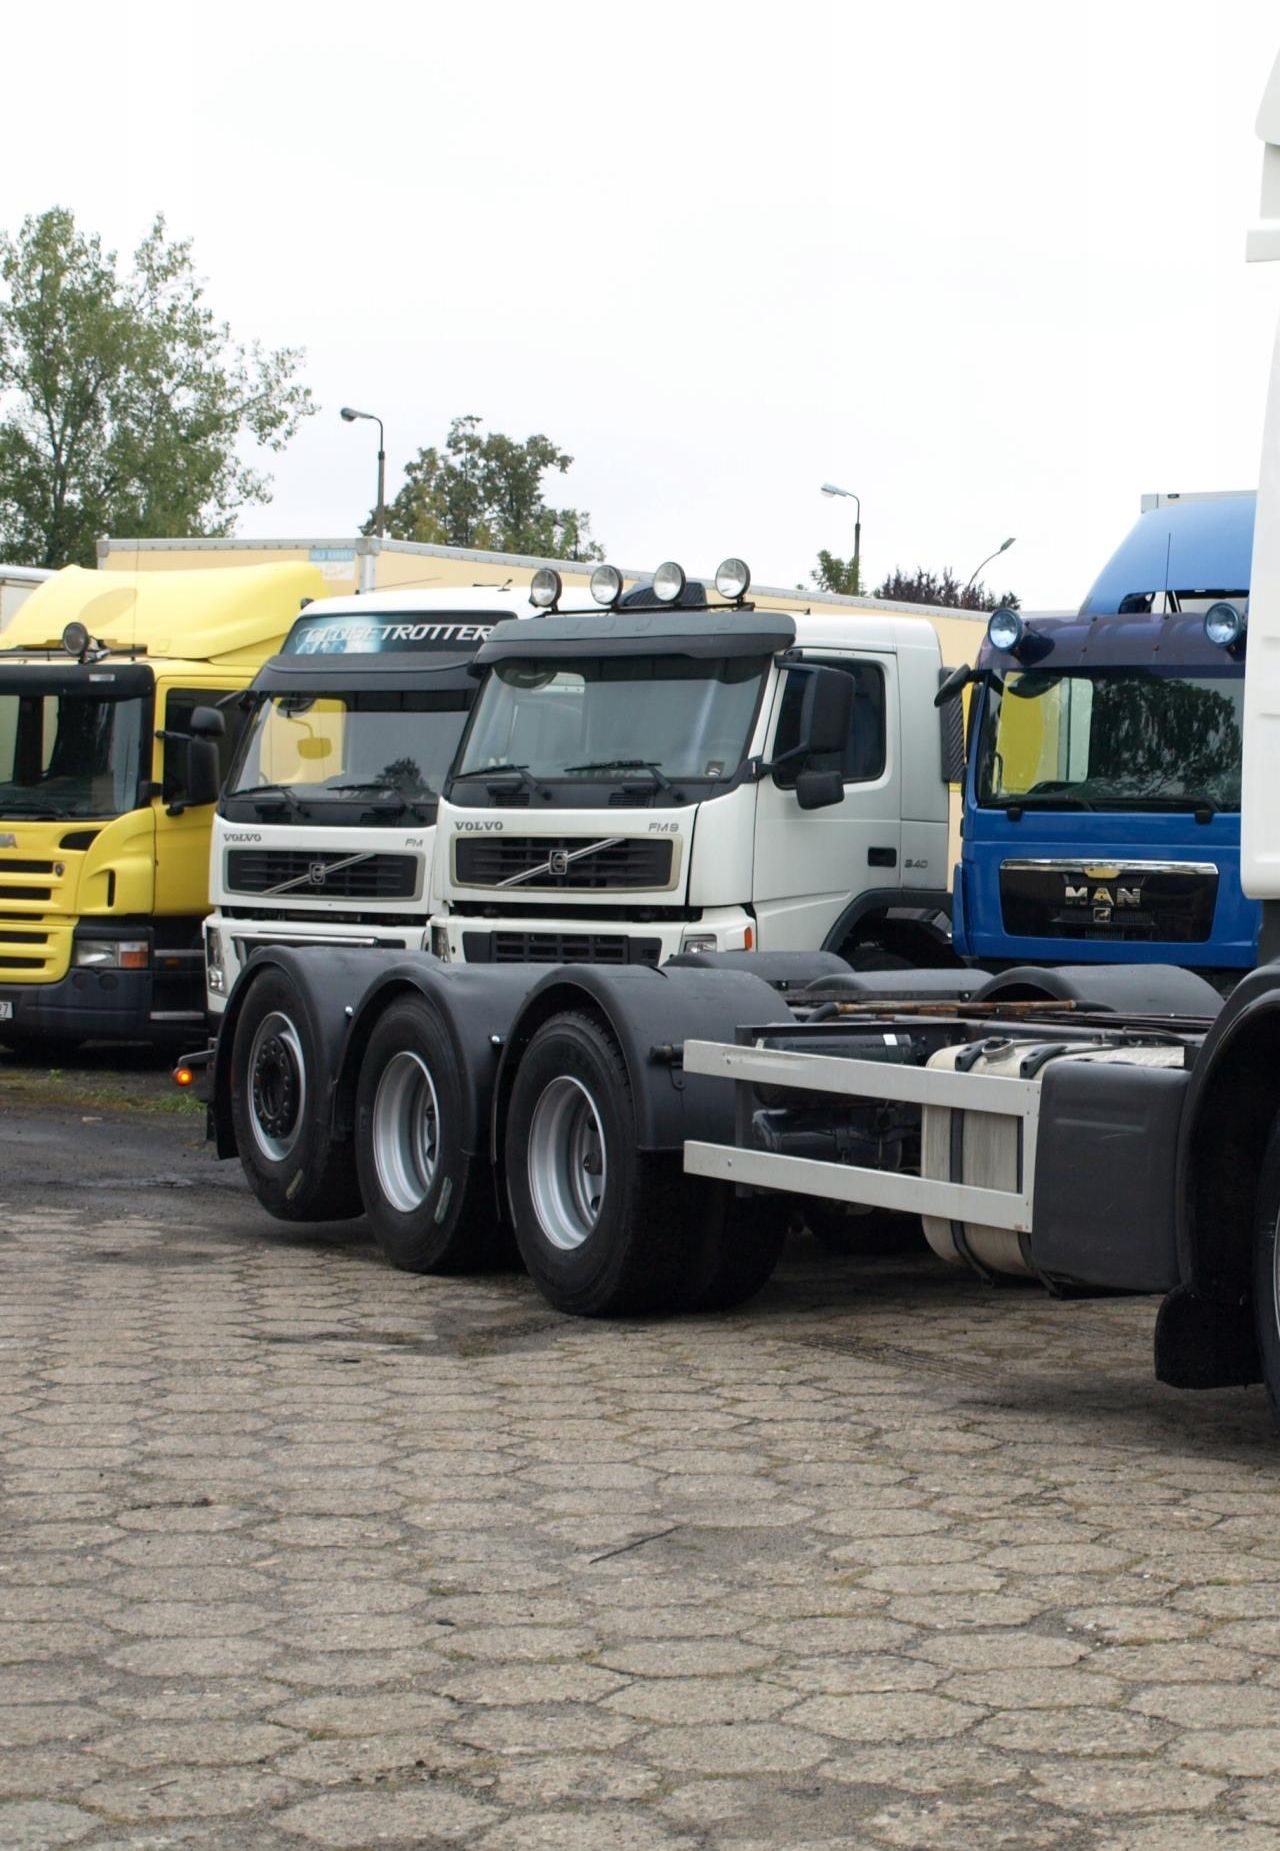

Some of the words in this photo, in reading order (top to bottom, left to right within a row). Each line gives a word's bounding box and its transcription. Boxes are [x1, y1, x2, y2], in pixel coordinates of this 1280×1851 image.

[454, 820, 504, 831] VOLVO
[648, 822, 679, 833] FM9
[223, 833, 262, 843] VOLVO
[405, 838, 424, 847] FM
[1065, 886, 1141, 906] MAN
